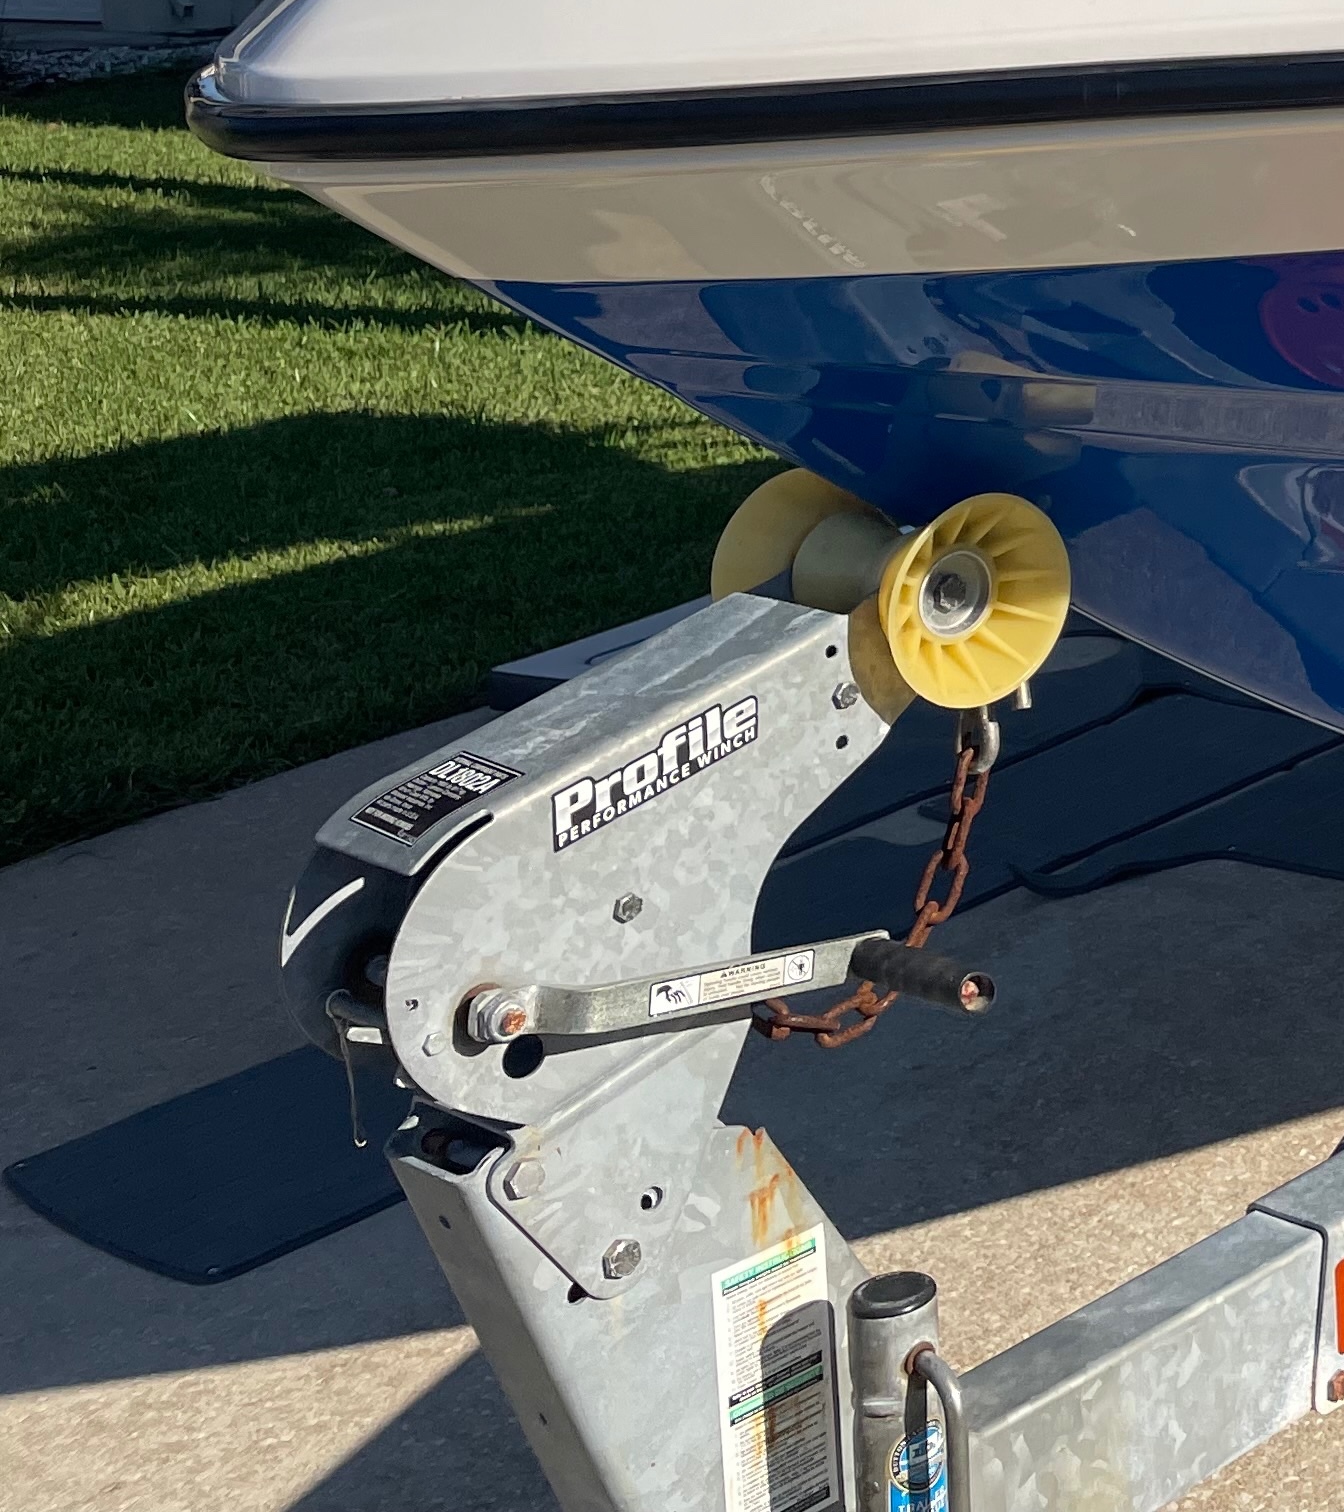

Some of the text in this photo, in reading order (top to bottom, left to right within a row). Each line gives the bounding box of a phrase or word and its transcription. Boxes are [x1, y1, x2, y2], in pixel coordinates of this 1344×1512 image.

[553, 696, 757, 836] Profile
[557, 726, 756, 848] PERFORMANCE WINCH
